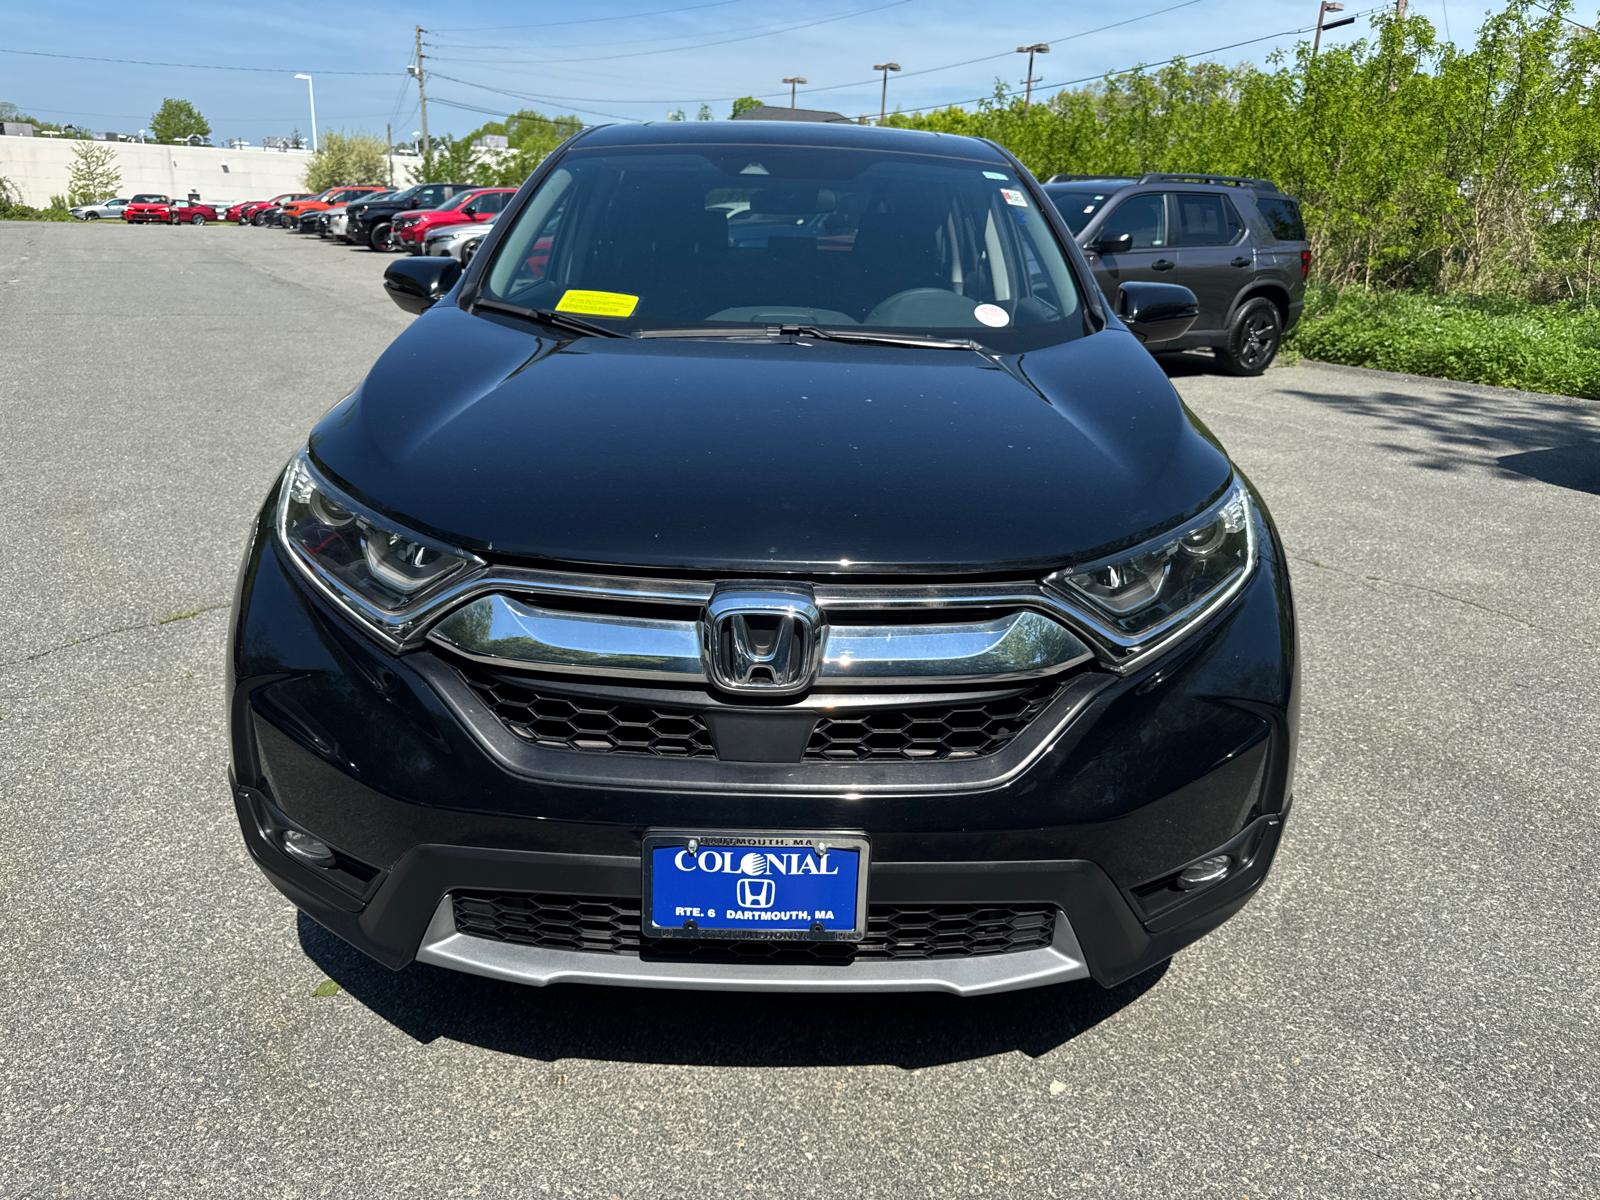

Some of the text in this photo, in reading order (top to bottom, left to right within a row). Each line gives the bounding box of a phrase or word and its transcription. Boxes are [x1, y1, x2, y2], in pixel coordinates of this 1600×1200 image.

[700, 837, 789, 846] DARTMOUTH,
[674, 850, 839, 876] COLONIAL
[675, 906, 835, 921] RTE. 6 DARTMOUTH, MA
